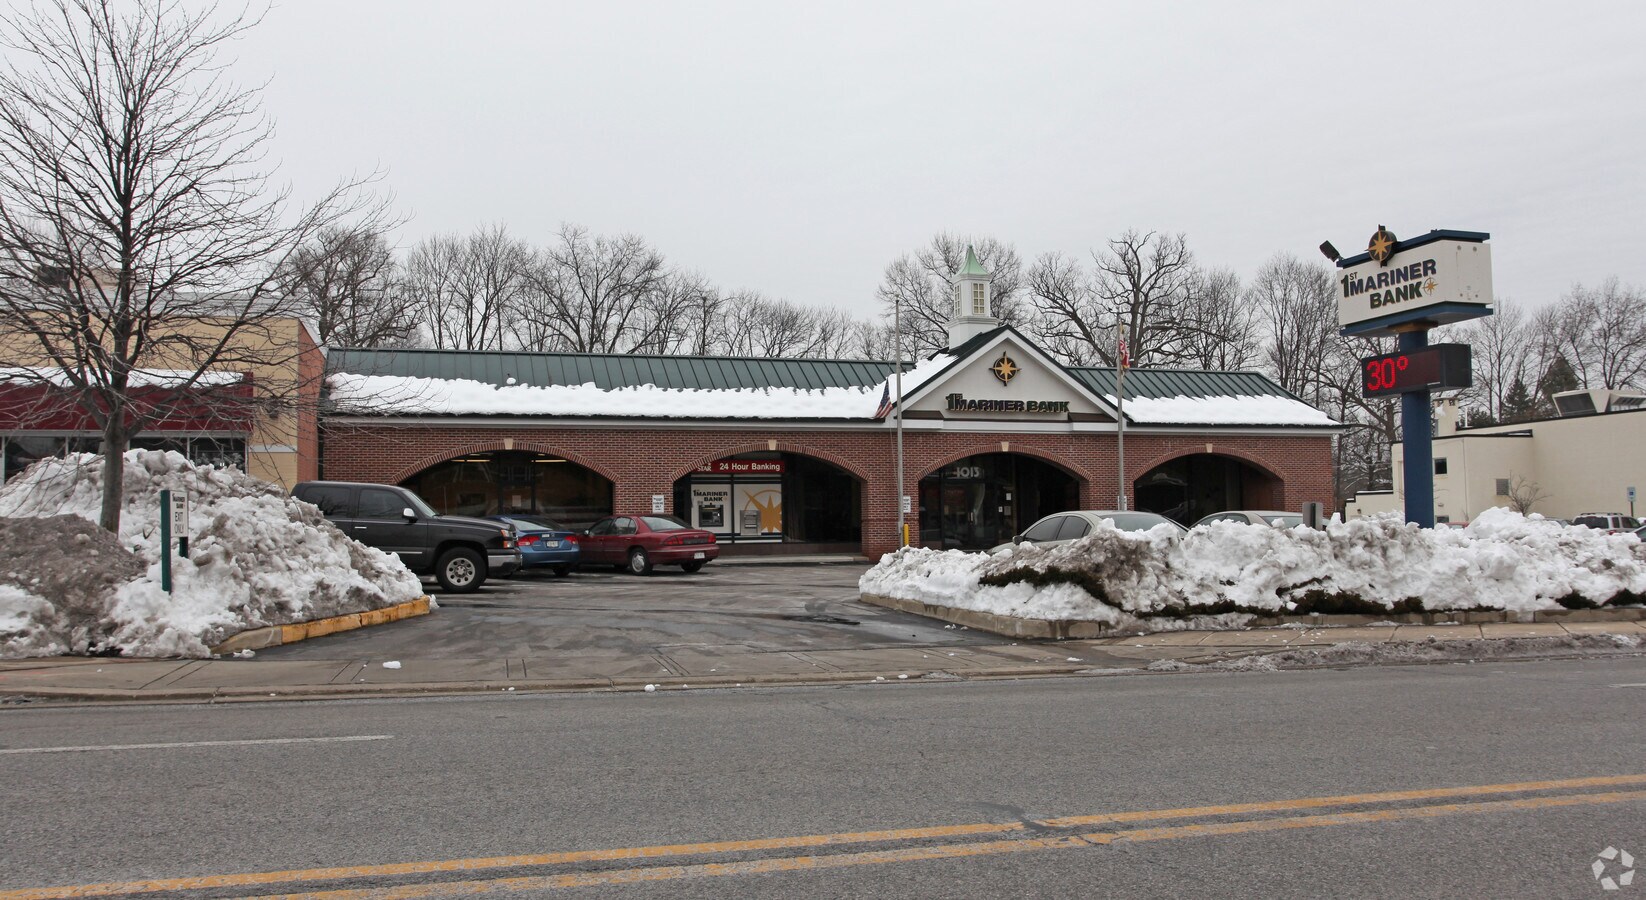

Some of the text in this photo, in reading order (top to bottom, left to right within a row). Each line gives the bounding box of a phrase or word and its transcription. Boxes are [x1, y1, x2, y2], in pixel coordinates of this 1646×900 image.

[1351, 259, 1437, 296] MARINER
[1370, 281, 1422, 309] BANK
[955, 399, 1025, 412] MARINER
[1026, 400, 1070, 413] BANK
[719, 462, 781, 472] 24 Hour Banking
[175, 511, 184, 522] EXIT
